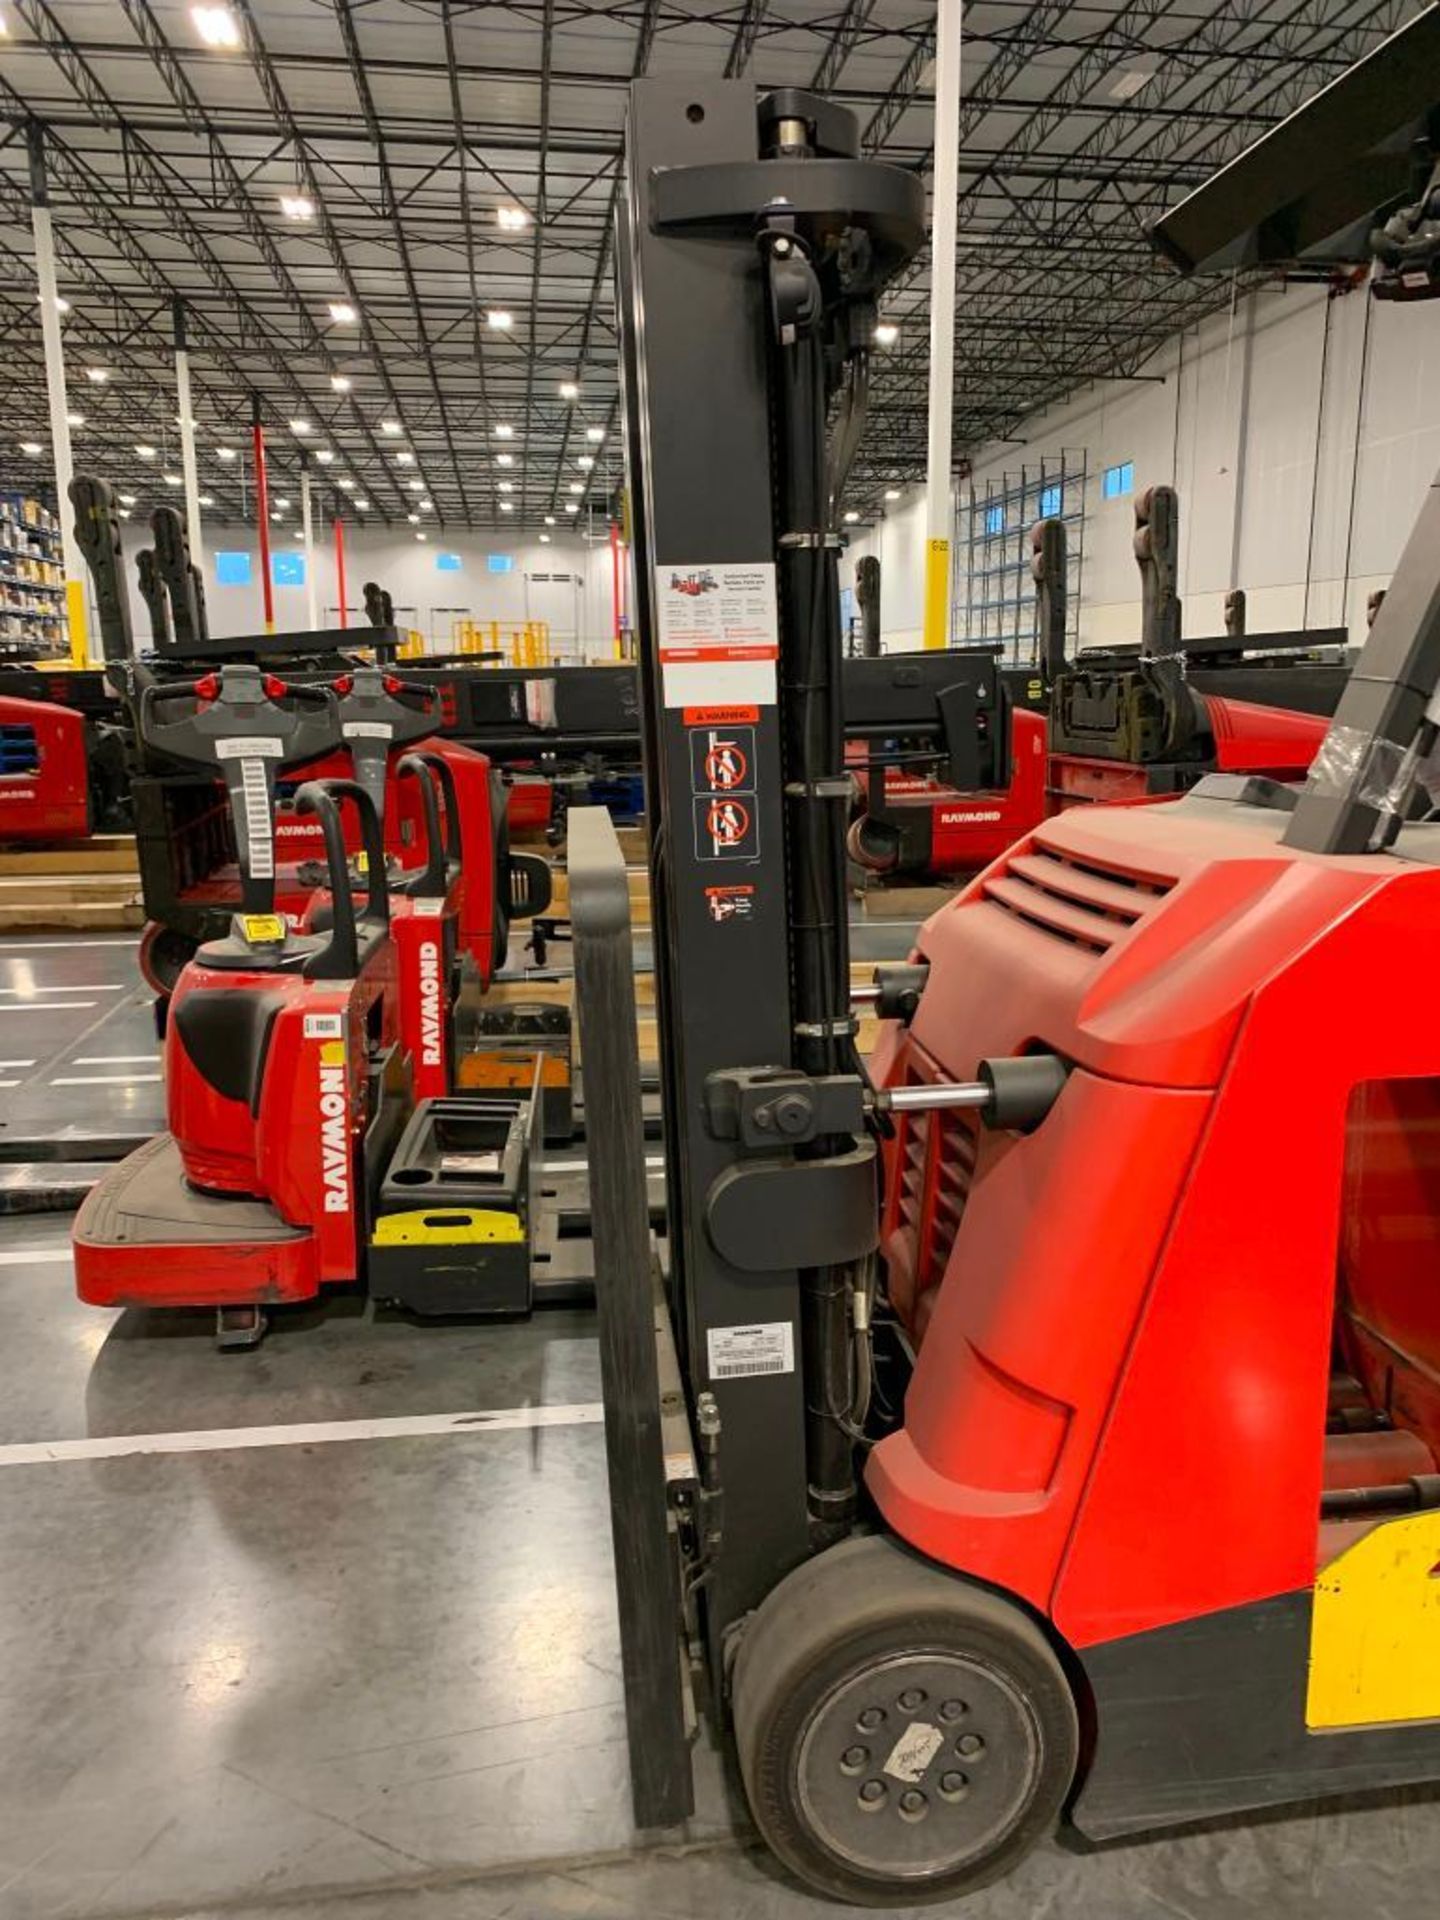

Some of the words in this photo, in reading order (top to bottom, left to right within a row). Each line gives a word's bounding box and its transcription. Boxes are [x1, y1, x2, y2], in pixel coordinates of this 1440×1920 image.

[706, 710, 750, 721] WARNING
[941, 811, 1001, 823] RAYMOND
[420, 941, 441, 1065] RAYMOND
[319, 1060, 349, 1213] RAYMON
